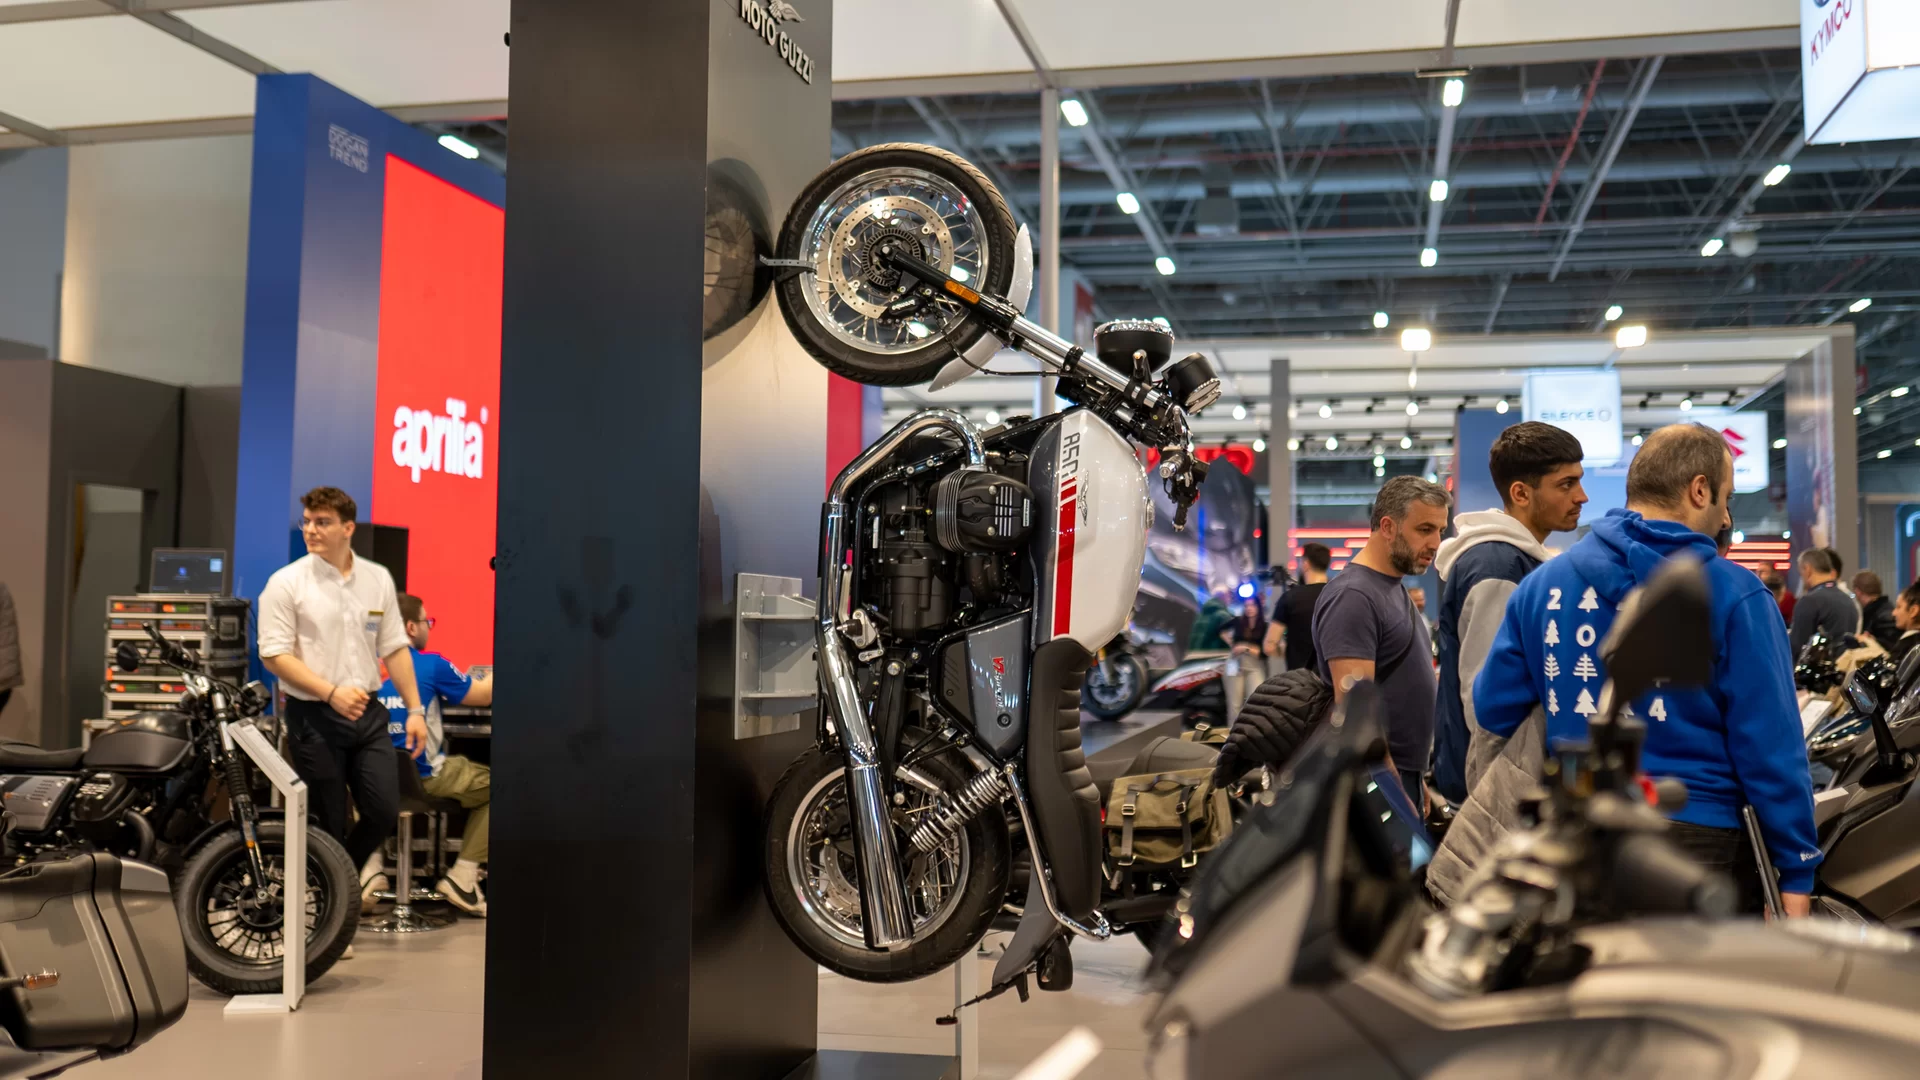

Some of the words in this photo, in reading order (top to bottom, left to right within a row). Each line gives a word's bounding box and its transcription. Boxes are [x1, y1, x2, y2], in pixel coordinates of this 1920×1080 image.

[741, 0, 777, 46] MOTO
[780, 31, 812, 85] GUZZI
[1811, 0, 1852, 66] KYMCO
[392, 397, 483, 483] aprilia
[1648, 697, 1668, 722] 4
